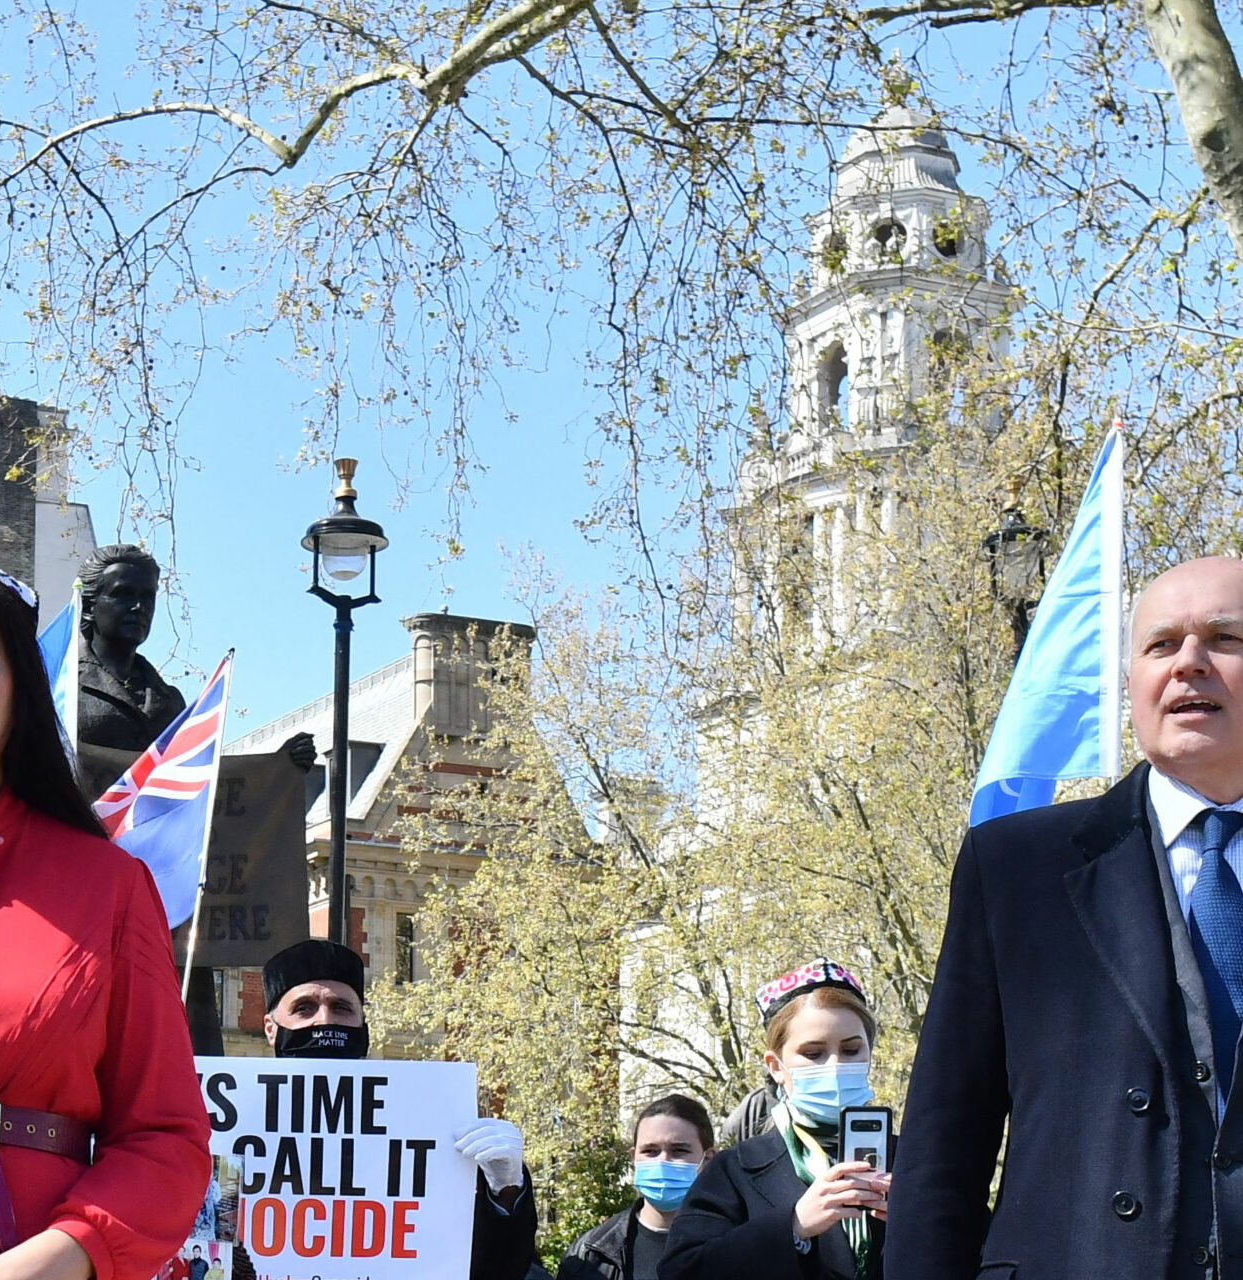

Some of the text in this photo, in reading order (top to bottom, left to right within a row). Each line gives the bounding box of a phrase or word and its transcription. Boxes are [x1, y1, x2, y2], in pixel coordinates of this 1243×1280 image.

[318, 1038, 345, 1047] MATTER
[257, 1074, 388, 1135] TIME
[232, 1135, 436, 1198] CALL IT
[239, 1197, 420, 1259] OCIDE
